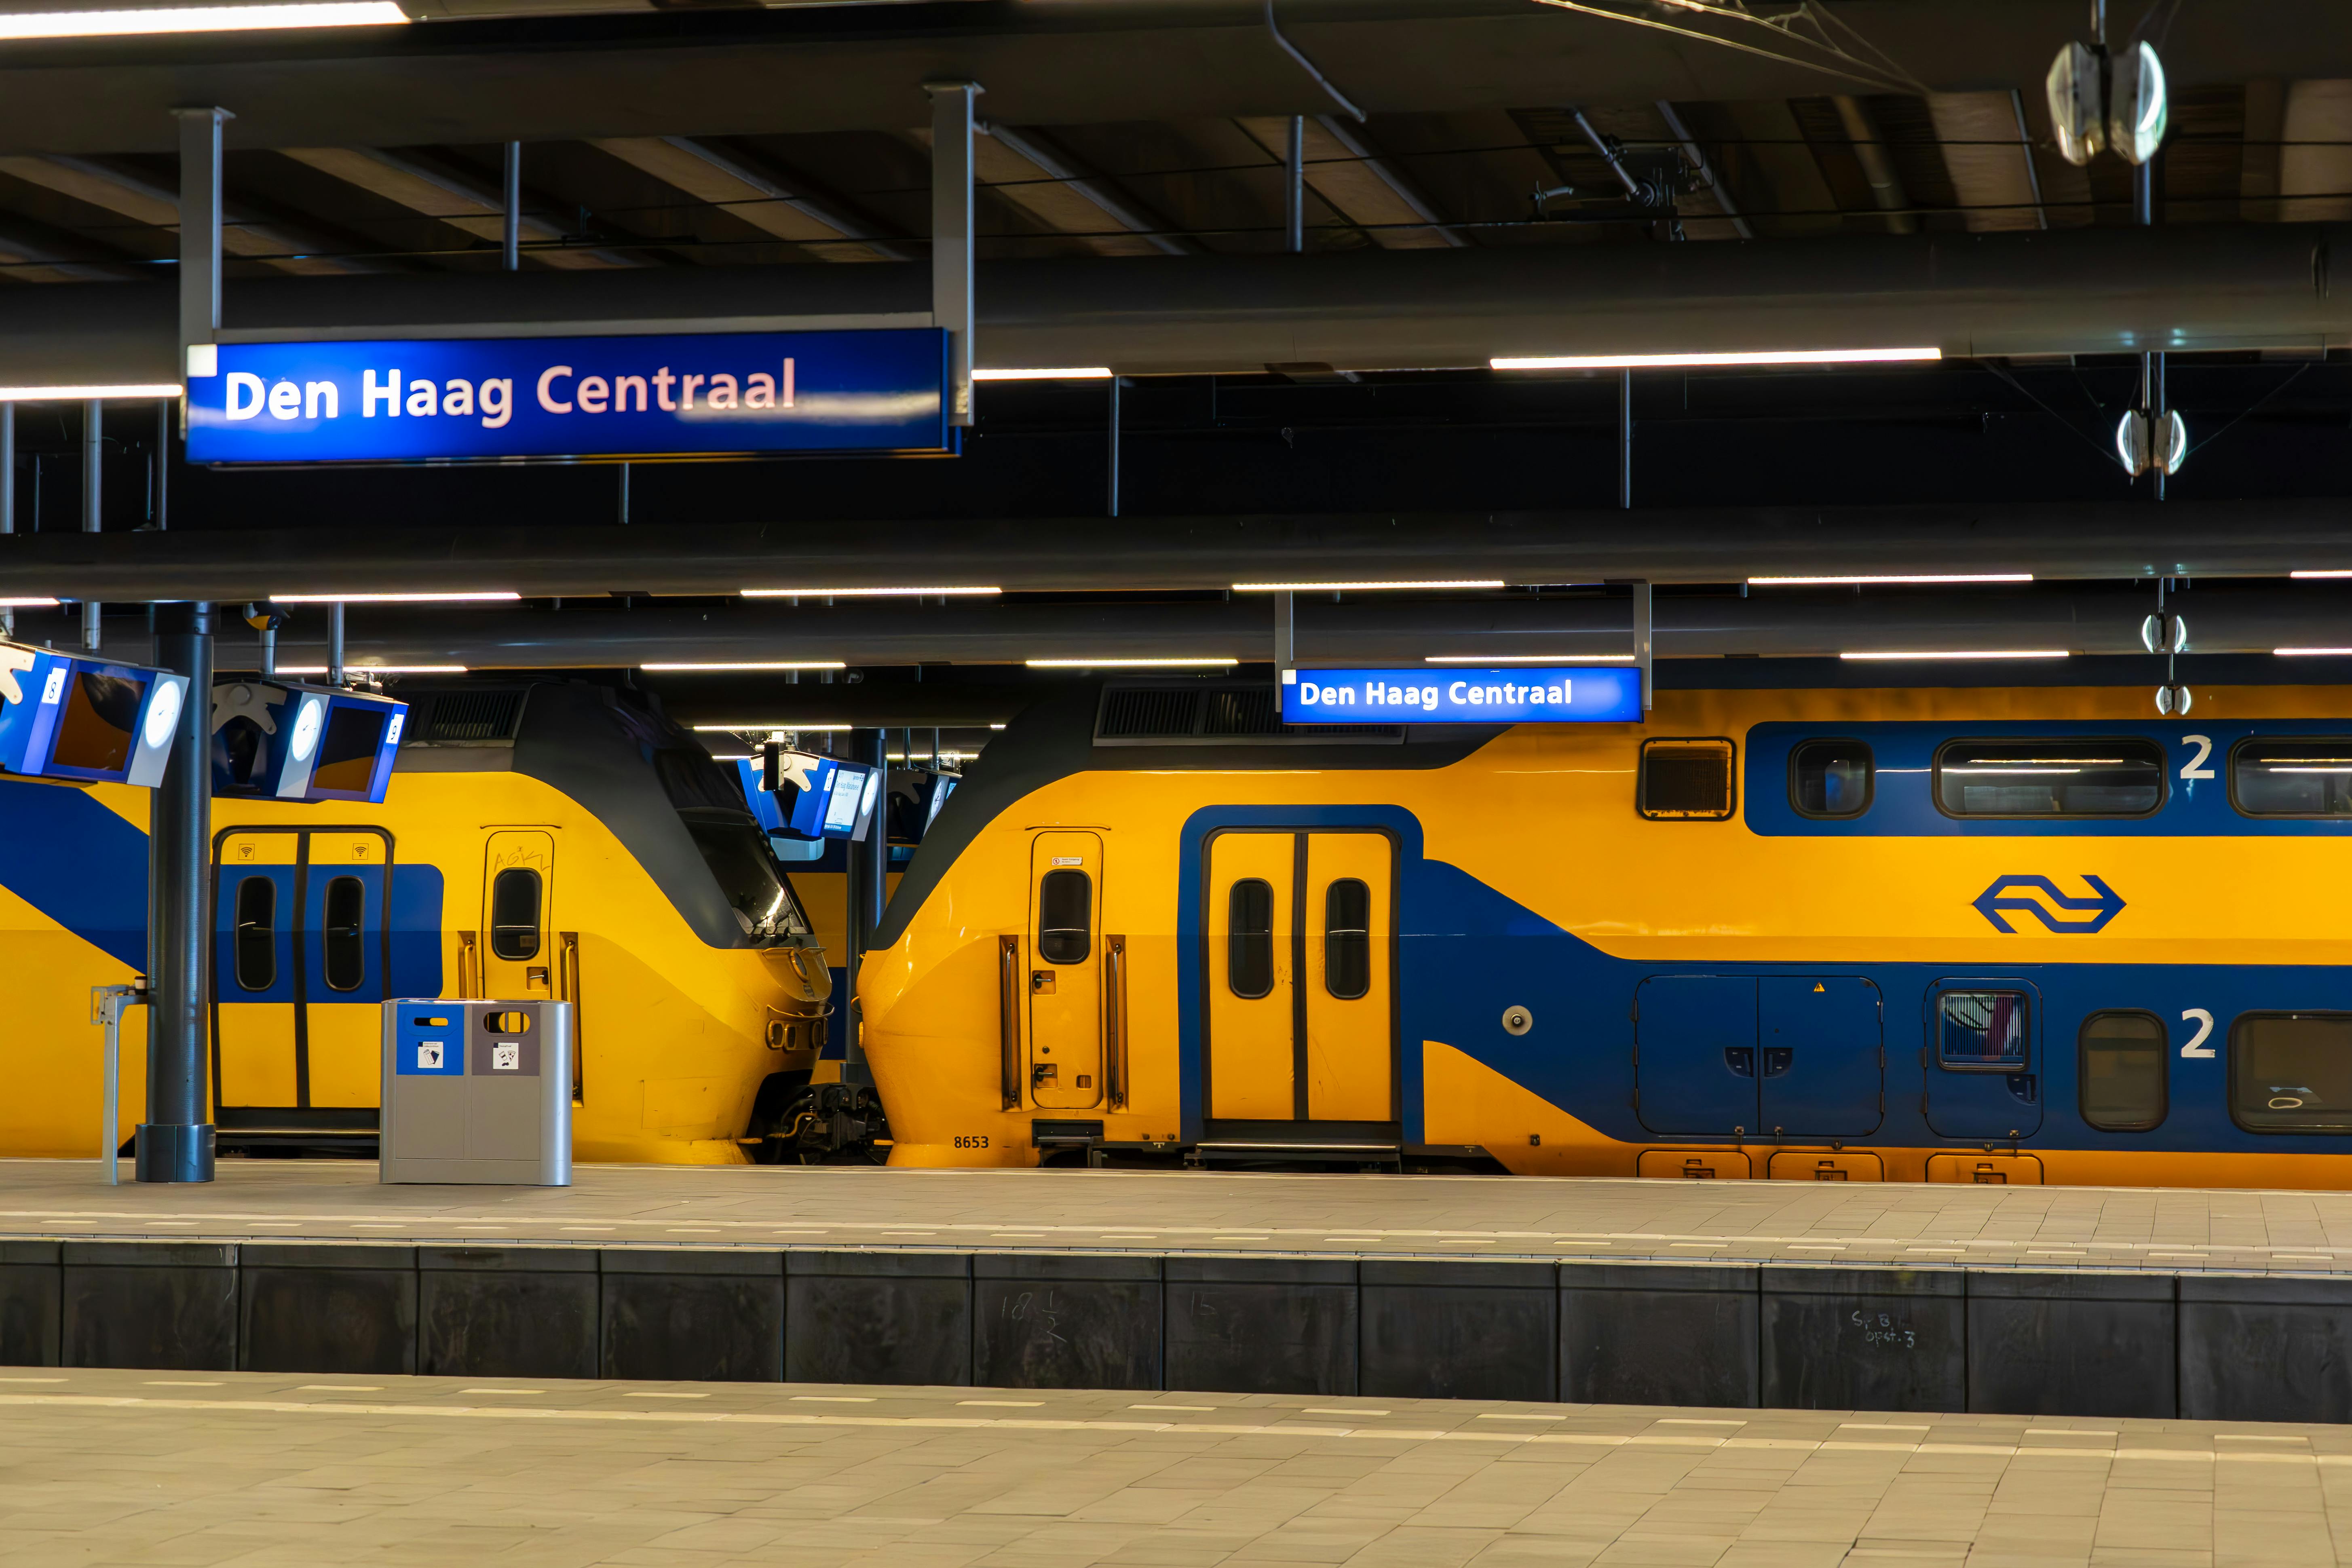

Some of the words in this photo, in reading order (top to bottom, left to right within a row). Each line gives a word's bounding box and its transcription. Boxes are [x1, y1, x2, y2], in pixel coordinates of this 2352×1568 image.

[226, 371, 339, 421] Den
[363, 368, 513, 429] Haag
[536, 357, 795, 414] Centraal
[49, 682, 56, 699] 8
[1301, 682, 1355, 705] Den
[1365, 682, 1438, 711] Haag
[1448, 679, 1572, 706] Centraal
[391, 725, 397, 740] 9
[2181, 735, 2215, 779] 2
[2181, 1008, 2215, 1058] 2
[954, 1136, 989, 1148] 8653
